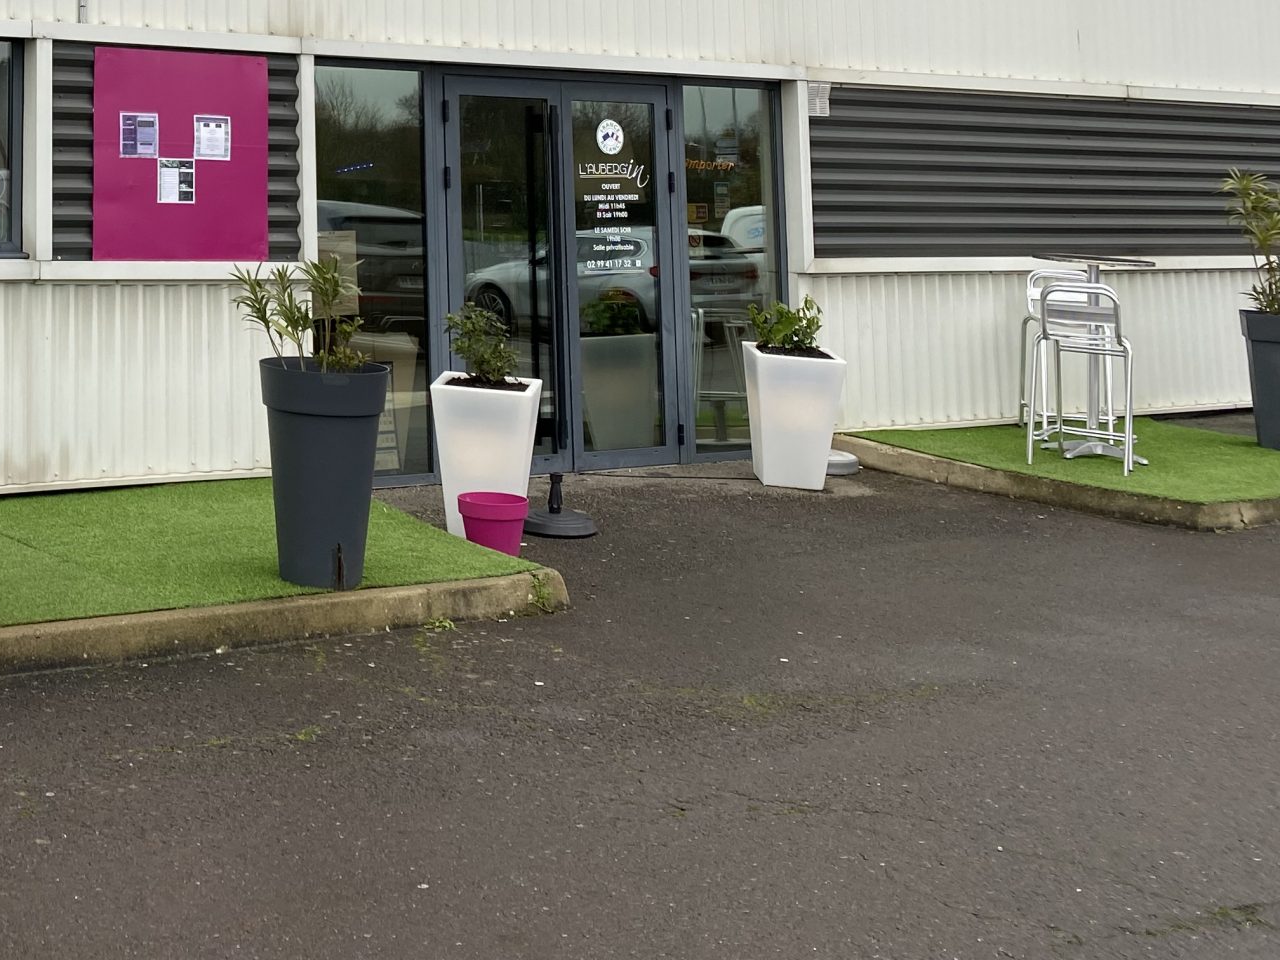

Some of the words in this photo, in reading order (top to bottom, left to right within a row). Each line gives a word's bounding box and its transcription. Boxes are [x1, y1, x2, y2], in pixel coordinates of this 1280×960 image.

[594, 226, 600, 234] LE
[600, 226, 620, 234] SAMEDI
[586, 260, 596, 269] 02
[596, 260, 605, 268] 99
[605, 260, 613, 268] 41
[614, 259, 622, 268] 17
[623, 259, 632, 268] 32
